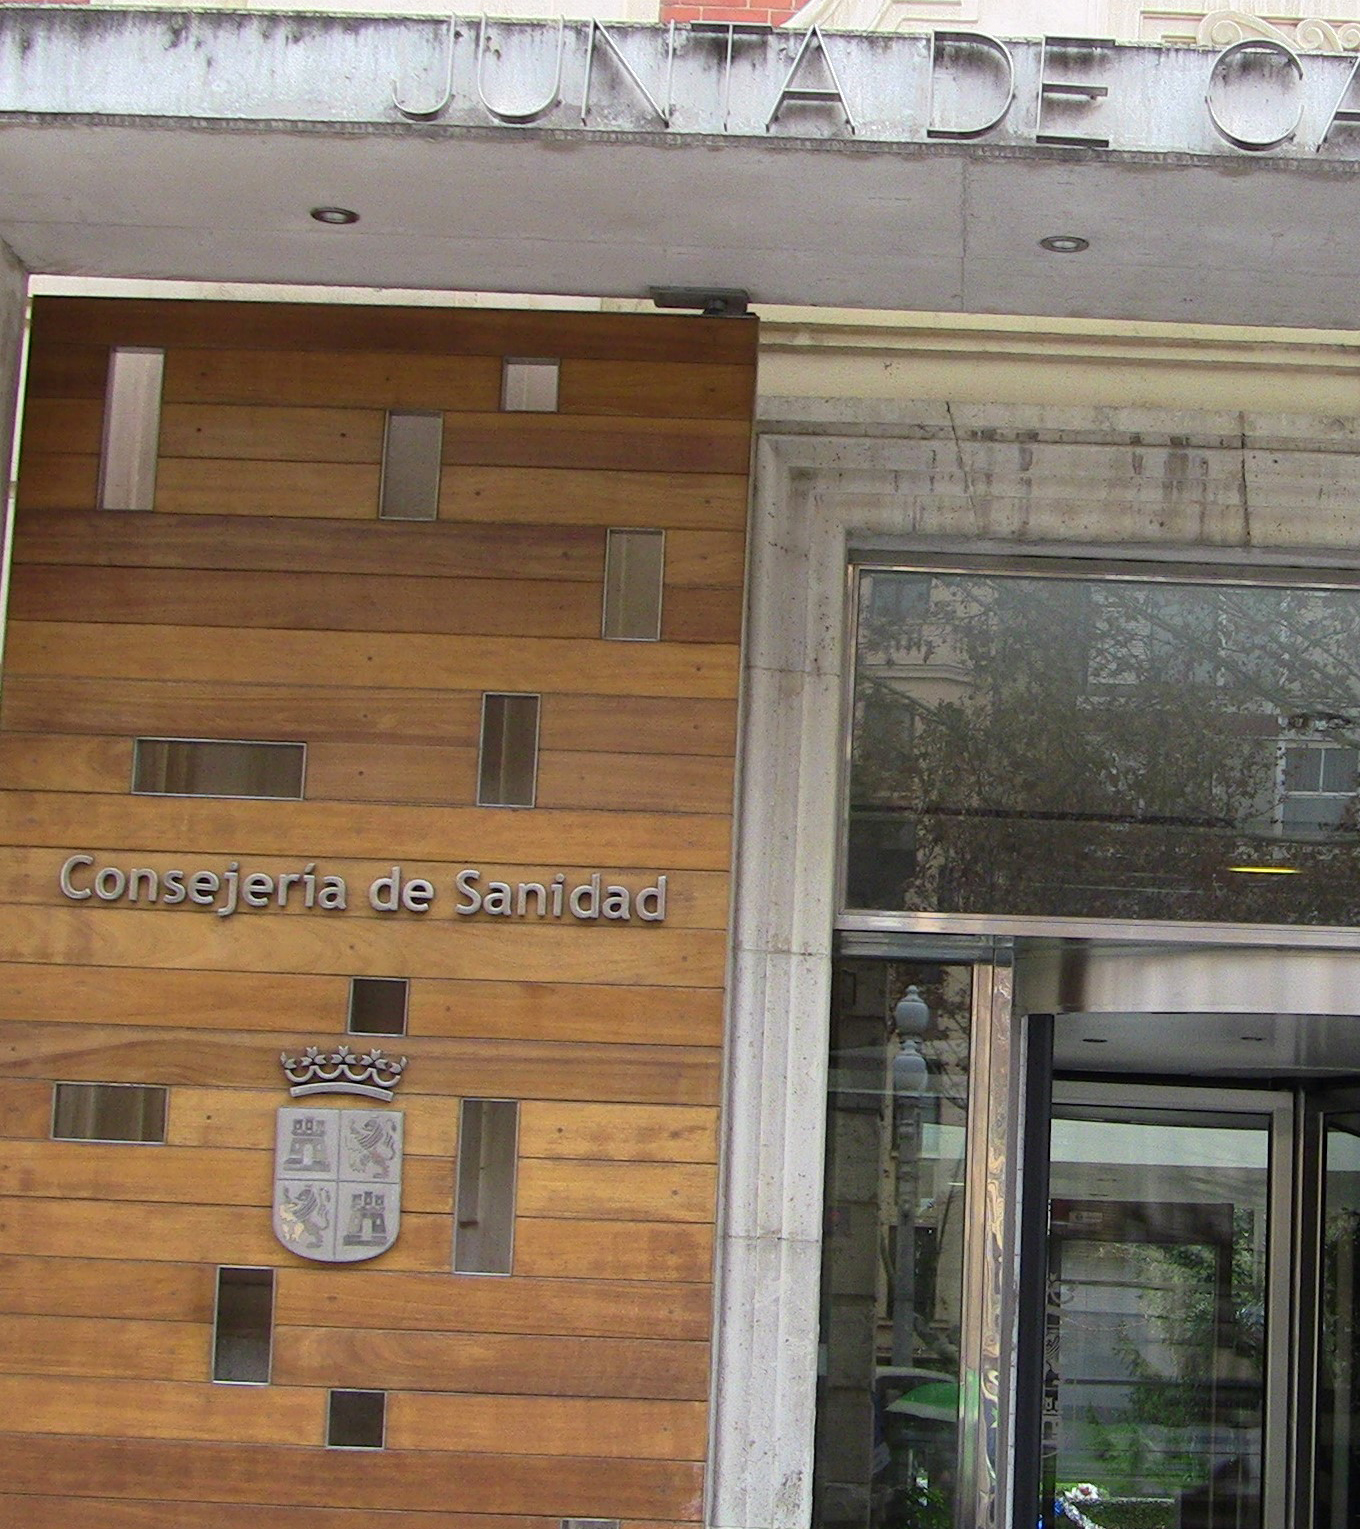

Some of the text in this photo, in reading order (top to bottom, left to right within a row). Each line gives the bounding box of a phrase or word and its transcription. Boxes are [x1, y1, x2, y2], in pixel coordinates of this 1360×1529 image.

[392, 12, 855, 136] JUNTA
[926, 30, 1117, 148] DE
[59, 854, 668, 923] Consejería de Sanidad
